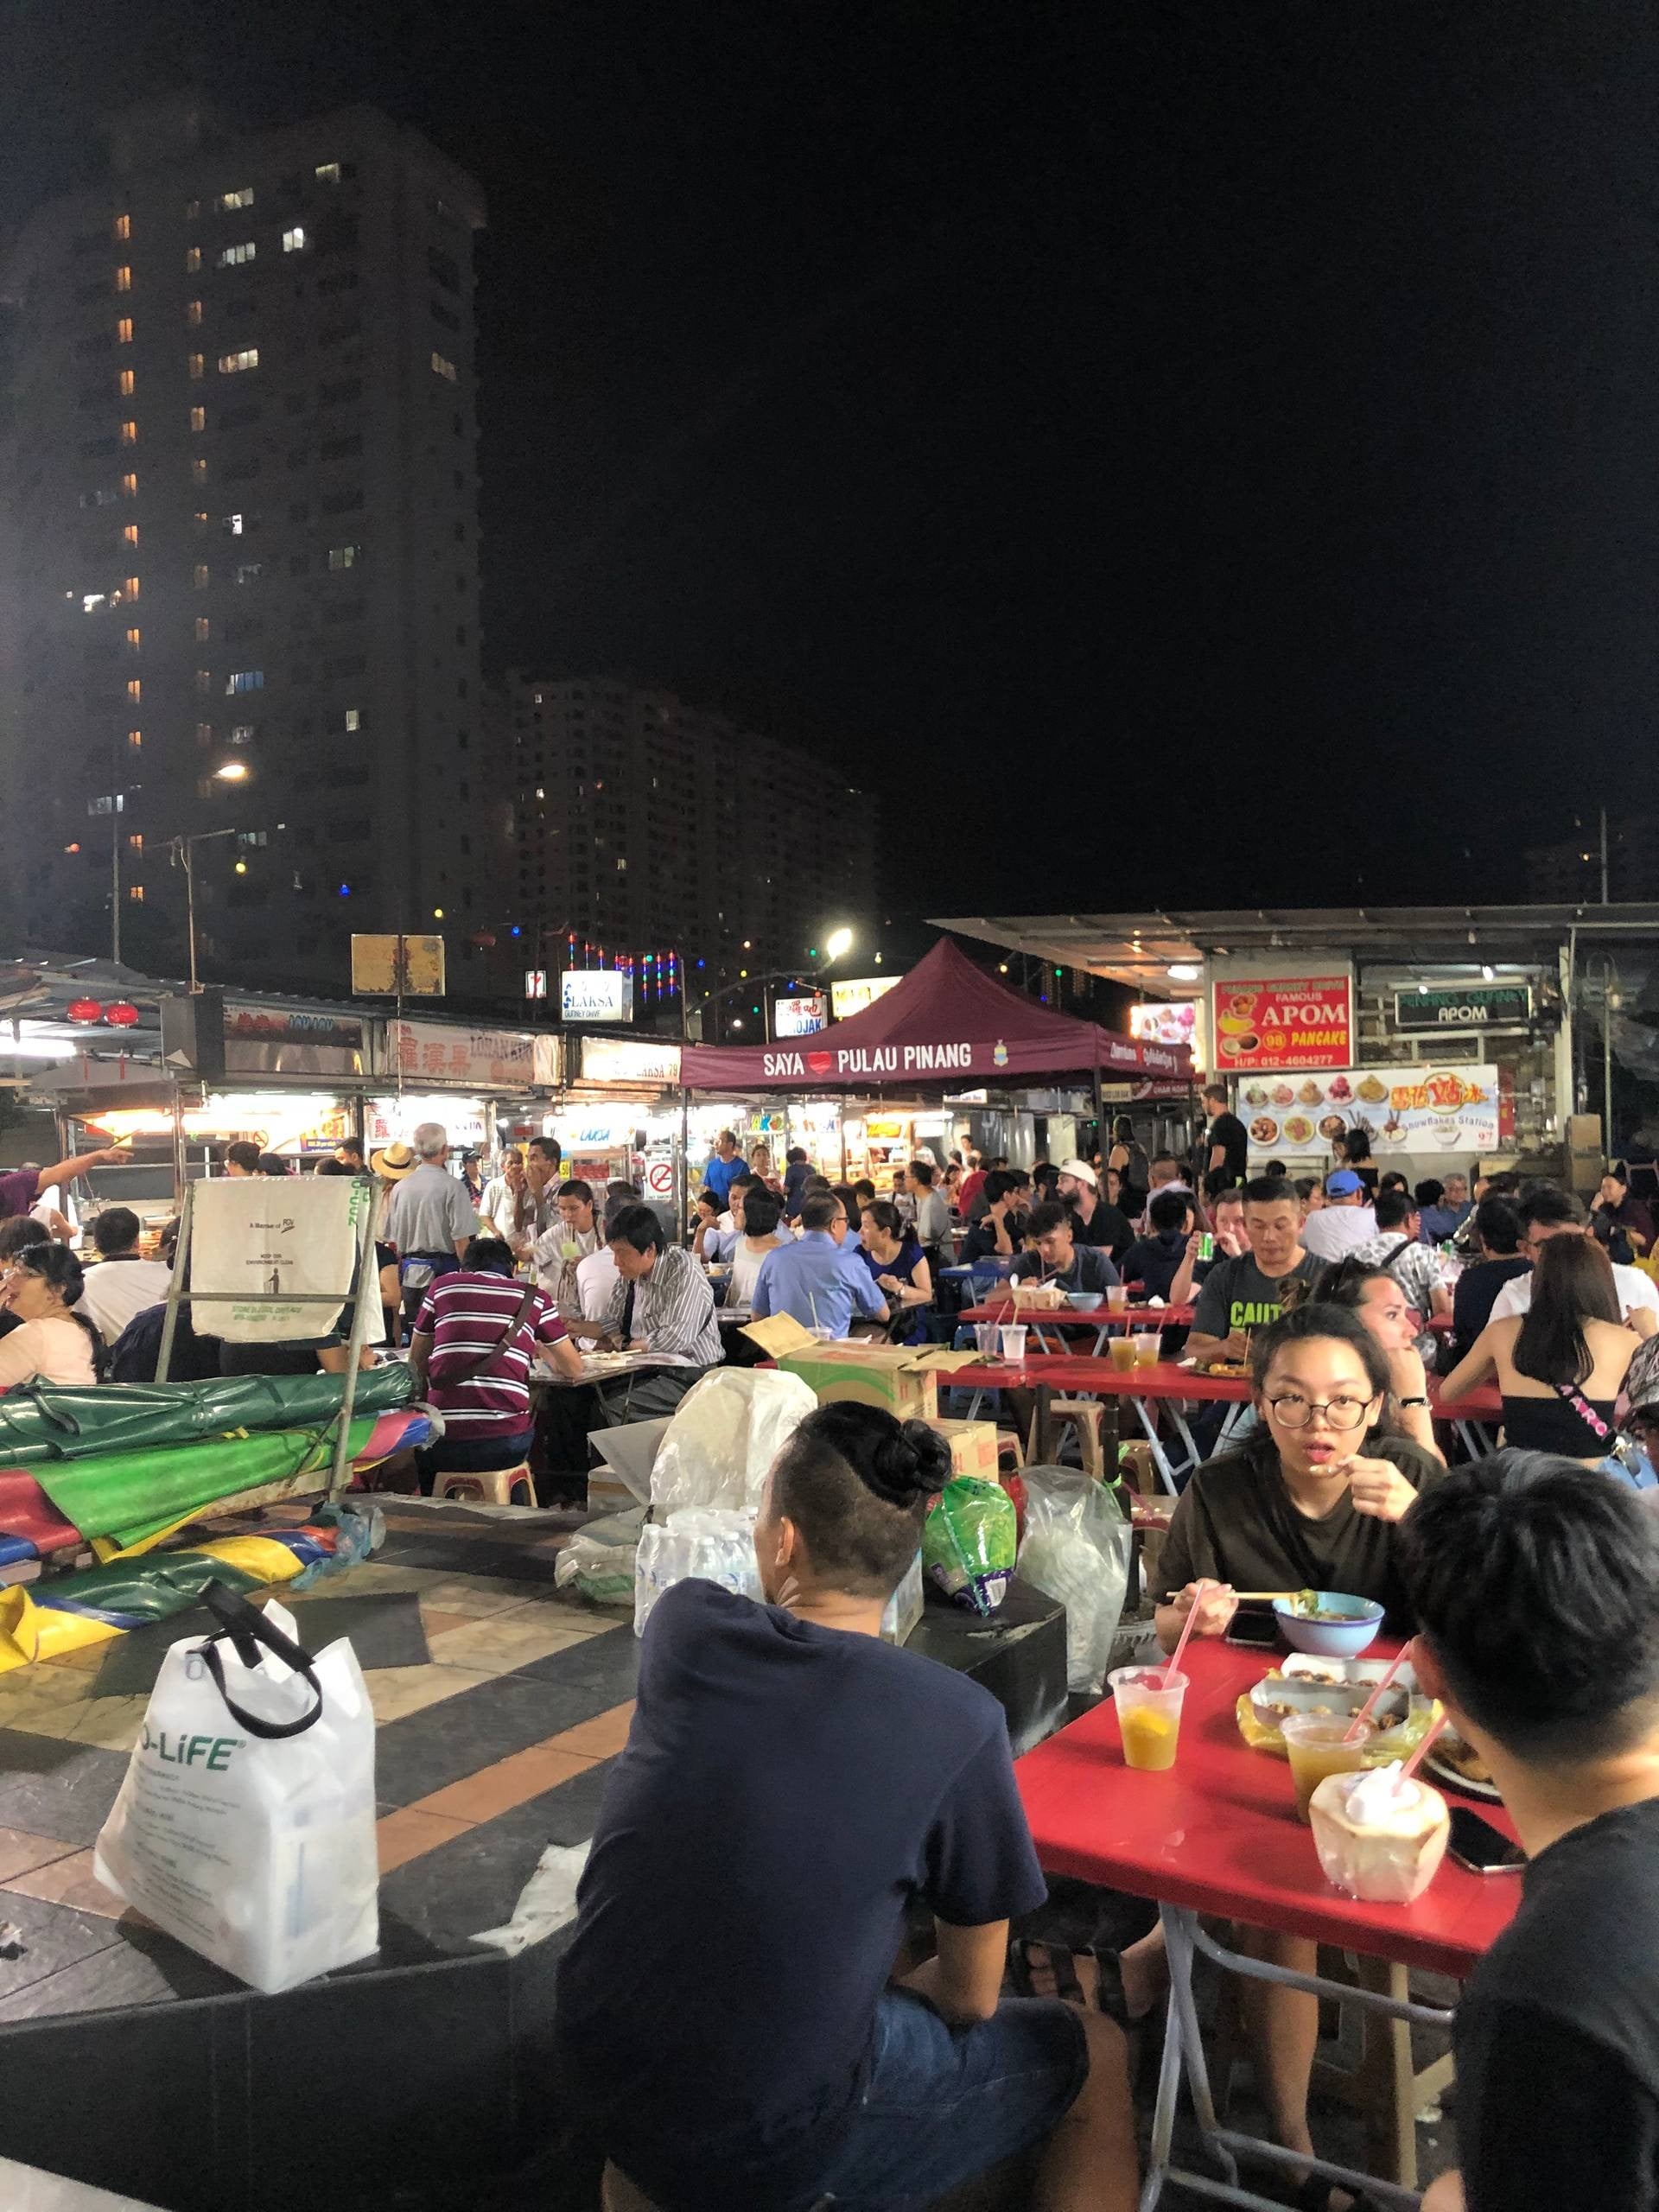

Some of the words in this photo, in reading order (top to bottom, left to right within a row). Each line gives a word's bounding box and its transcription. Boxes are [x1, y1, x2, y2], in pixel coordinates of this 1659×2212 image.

[571, 995, 613, 1007] LAKSA
[1275, 992, 1322, 1002] FAMOUS
[1261, 1003, 1347, 1027] APOM
[1439, 1005, 1488, 1022] APOM
[1266, 1034, 1283, 1047] 98
[1291, 1030, 1347, 1046] PANCAKE
[763, 1052, 805, 1077] SAYA
[837, 1046, 898, 1074] PULAU
[904, 1043, 972, 1071] PINANG
[669, 1063, 678, 1077] 79
[1459, 1116, 1495, 1129] Station
